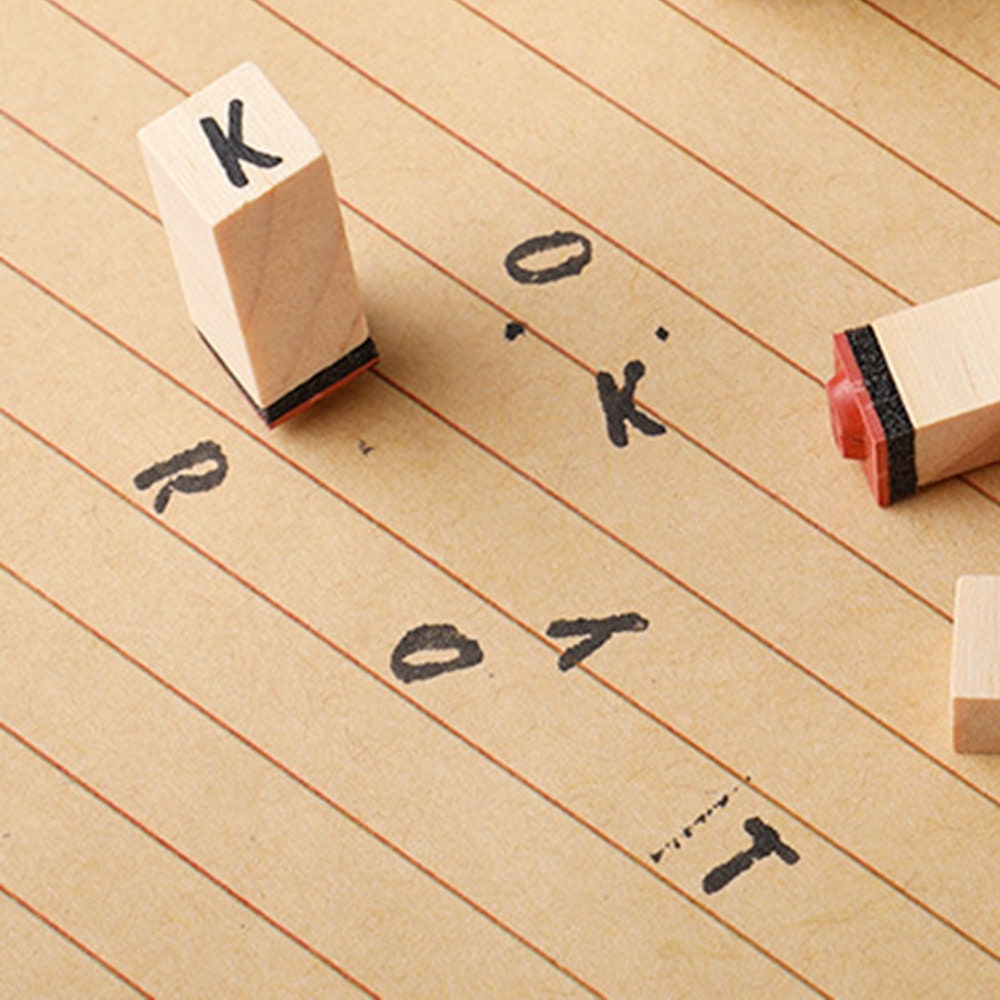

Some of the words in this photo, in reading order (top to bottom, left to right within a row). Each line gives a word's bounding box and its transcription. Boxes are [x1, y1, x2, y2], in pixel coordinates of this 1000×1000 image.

[200, 99, 282, 188] K
[596, 360, 666, 448] K
[134, 441, 228, 513] R
[703, 817, 800, 894] T
